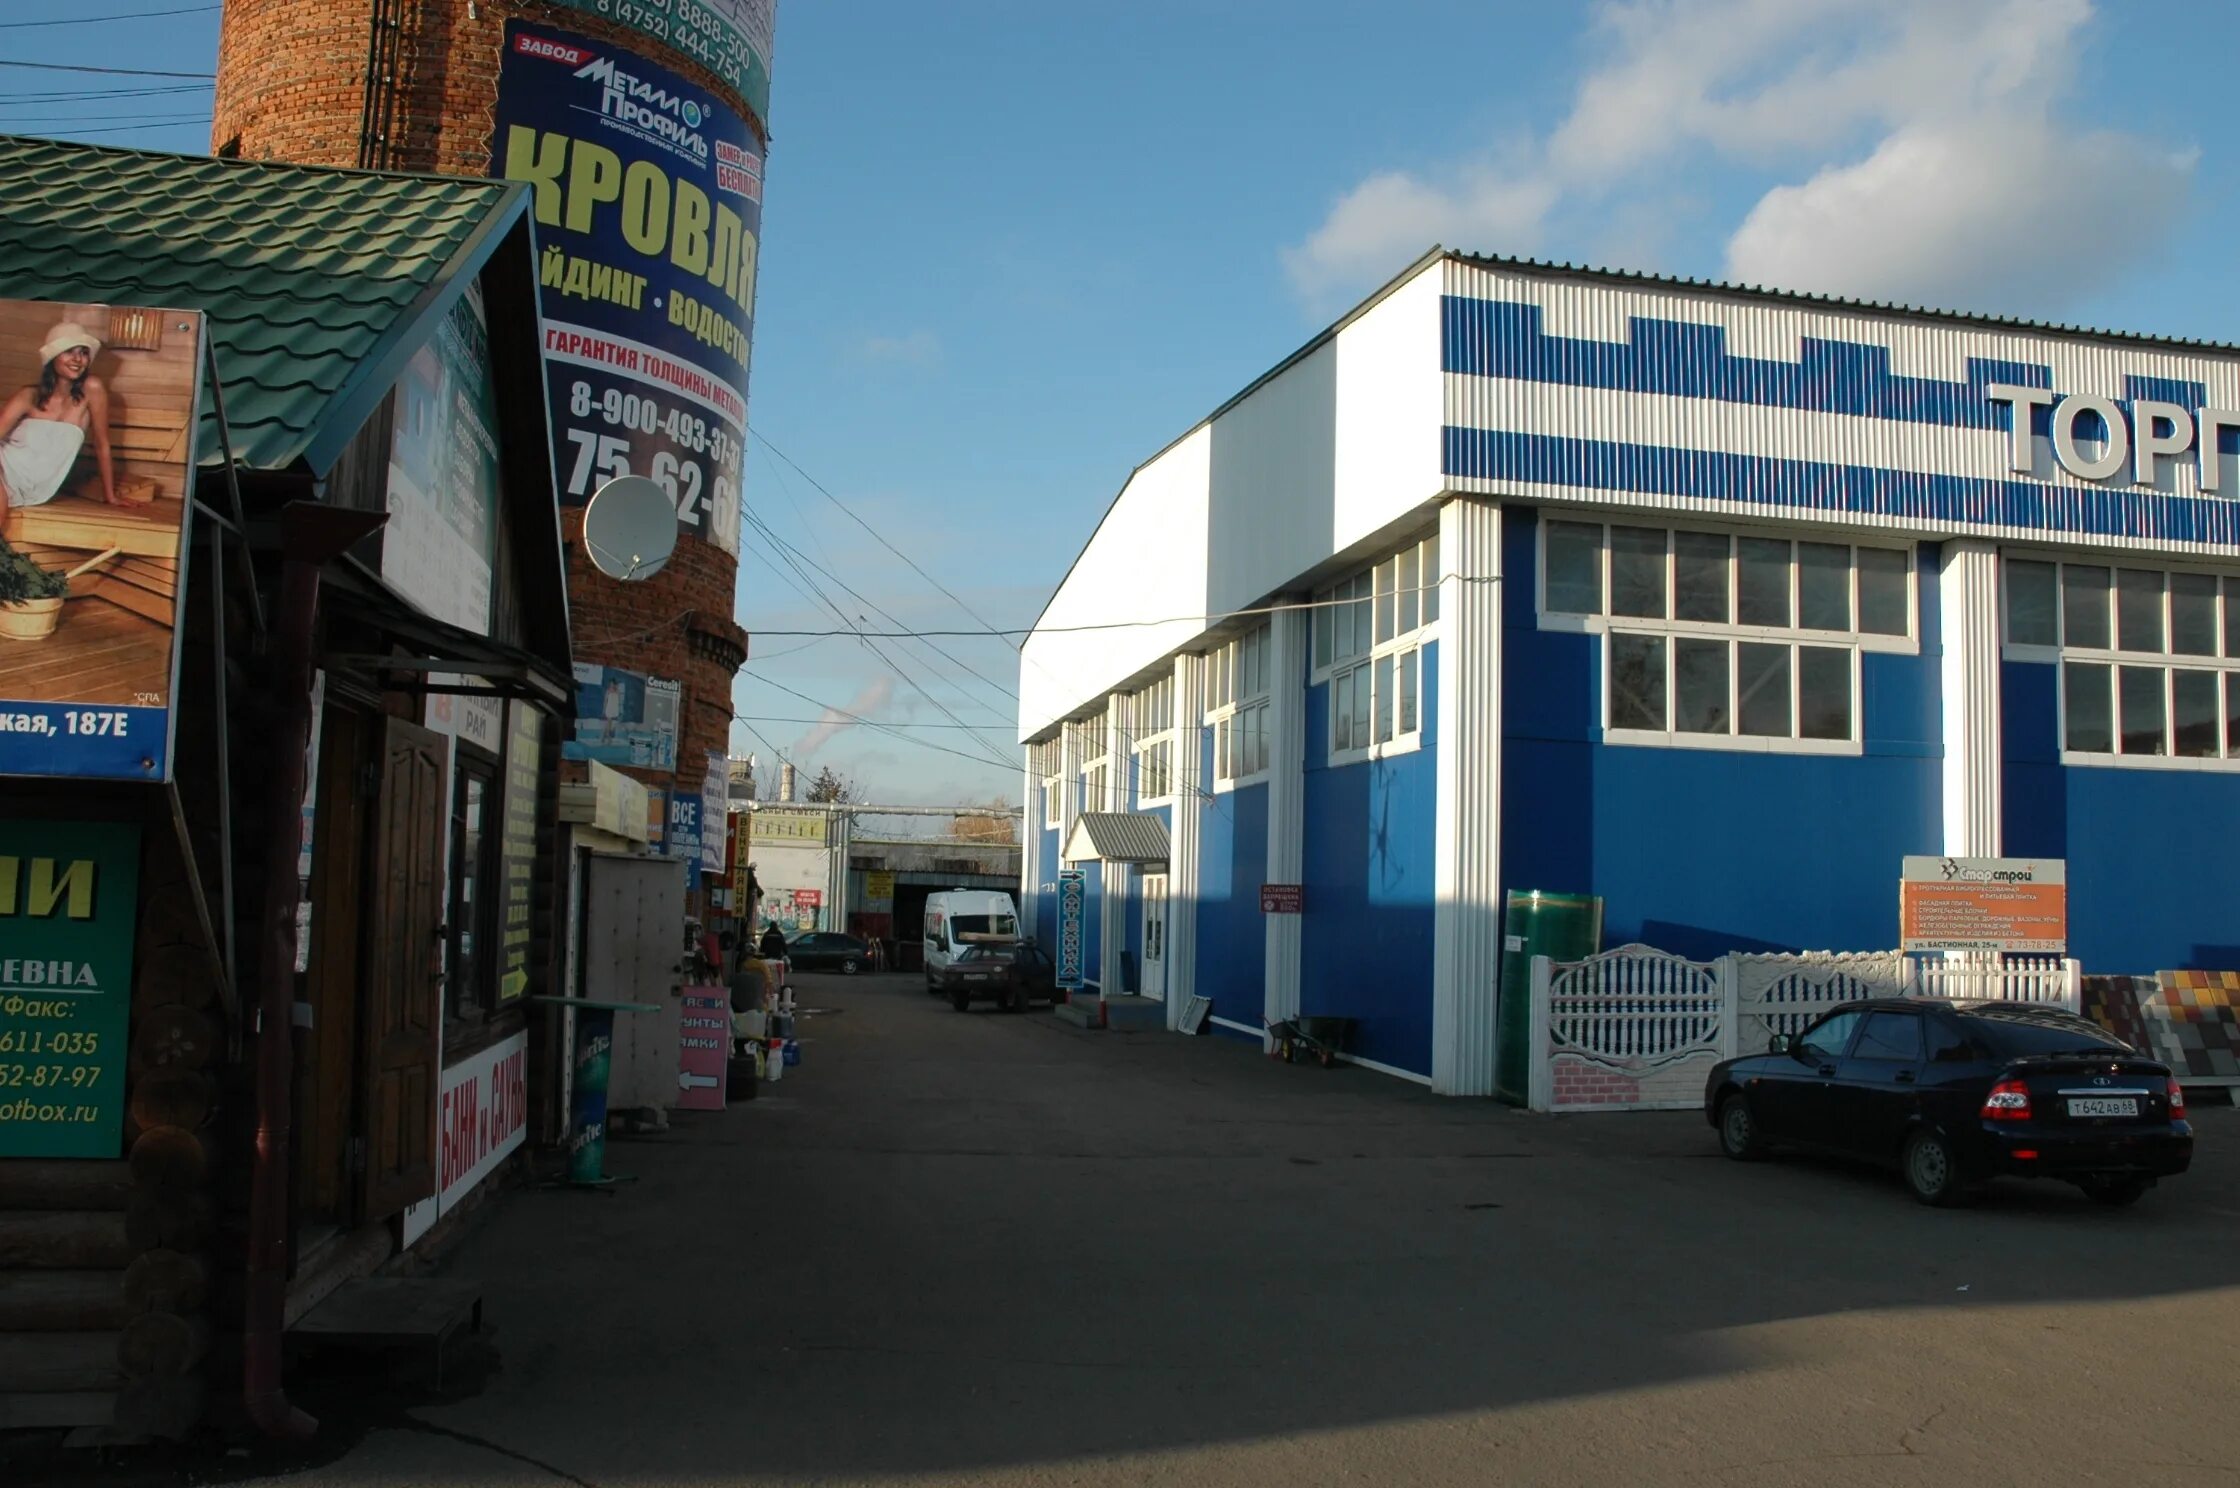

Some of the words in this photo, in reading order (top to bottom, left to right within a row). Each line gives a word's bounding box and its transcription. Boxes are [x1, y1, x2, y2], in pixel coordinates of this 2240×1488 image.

[519, 37, 578, 63] ЗАВОД
[615, 0, 670, 41] (4752)
[674, 24, 741, 88] 444-754
[676, 0, 750, 70] 8888-500
[601, 86, 708, 160] ПРОФИЛЬ
[505, 125, 758, 321] КРОВЛЯ
[545, 328, 639, 371] ГАРАНТИЯ
[641, 351, 712, 399] ТОЛЩИНЫ
[569, 380, 741, 476] 8-900-493-37-37
[647, 675, 680, 692] Ceresit
[0, 712, 57, 738] кая,
[65, 711, 129, 737] 187Е
[671, 800, 697, 826] ВСЕ
[735, 817, 748, 915] ВЕНТИЛЯЦИЯ
[1062, 882, 1081, 975] САНТЕХНИКА
[0, 958, 99, 987] ЕВНА
[0, 1030, 99, 1055] 611-035
[681, 1016, 724, 1029] УНТЫ
[441, 1075, 478, 1192] БАНИ
[490, 1045, 527, 1151] САУНЫ
